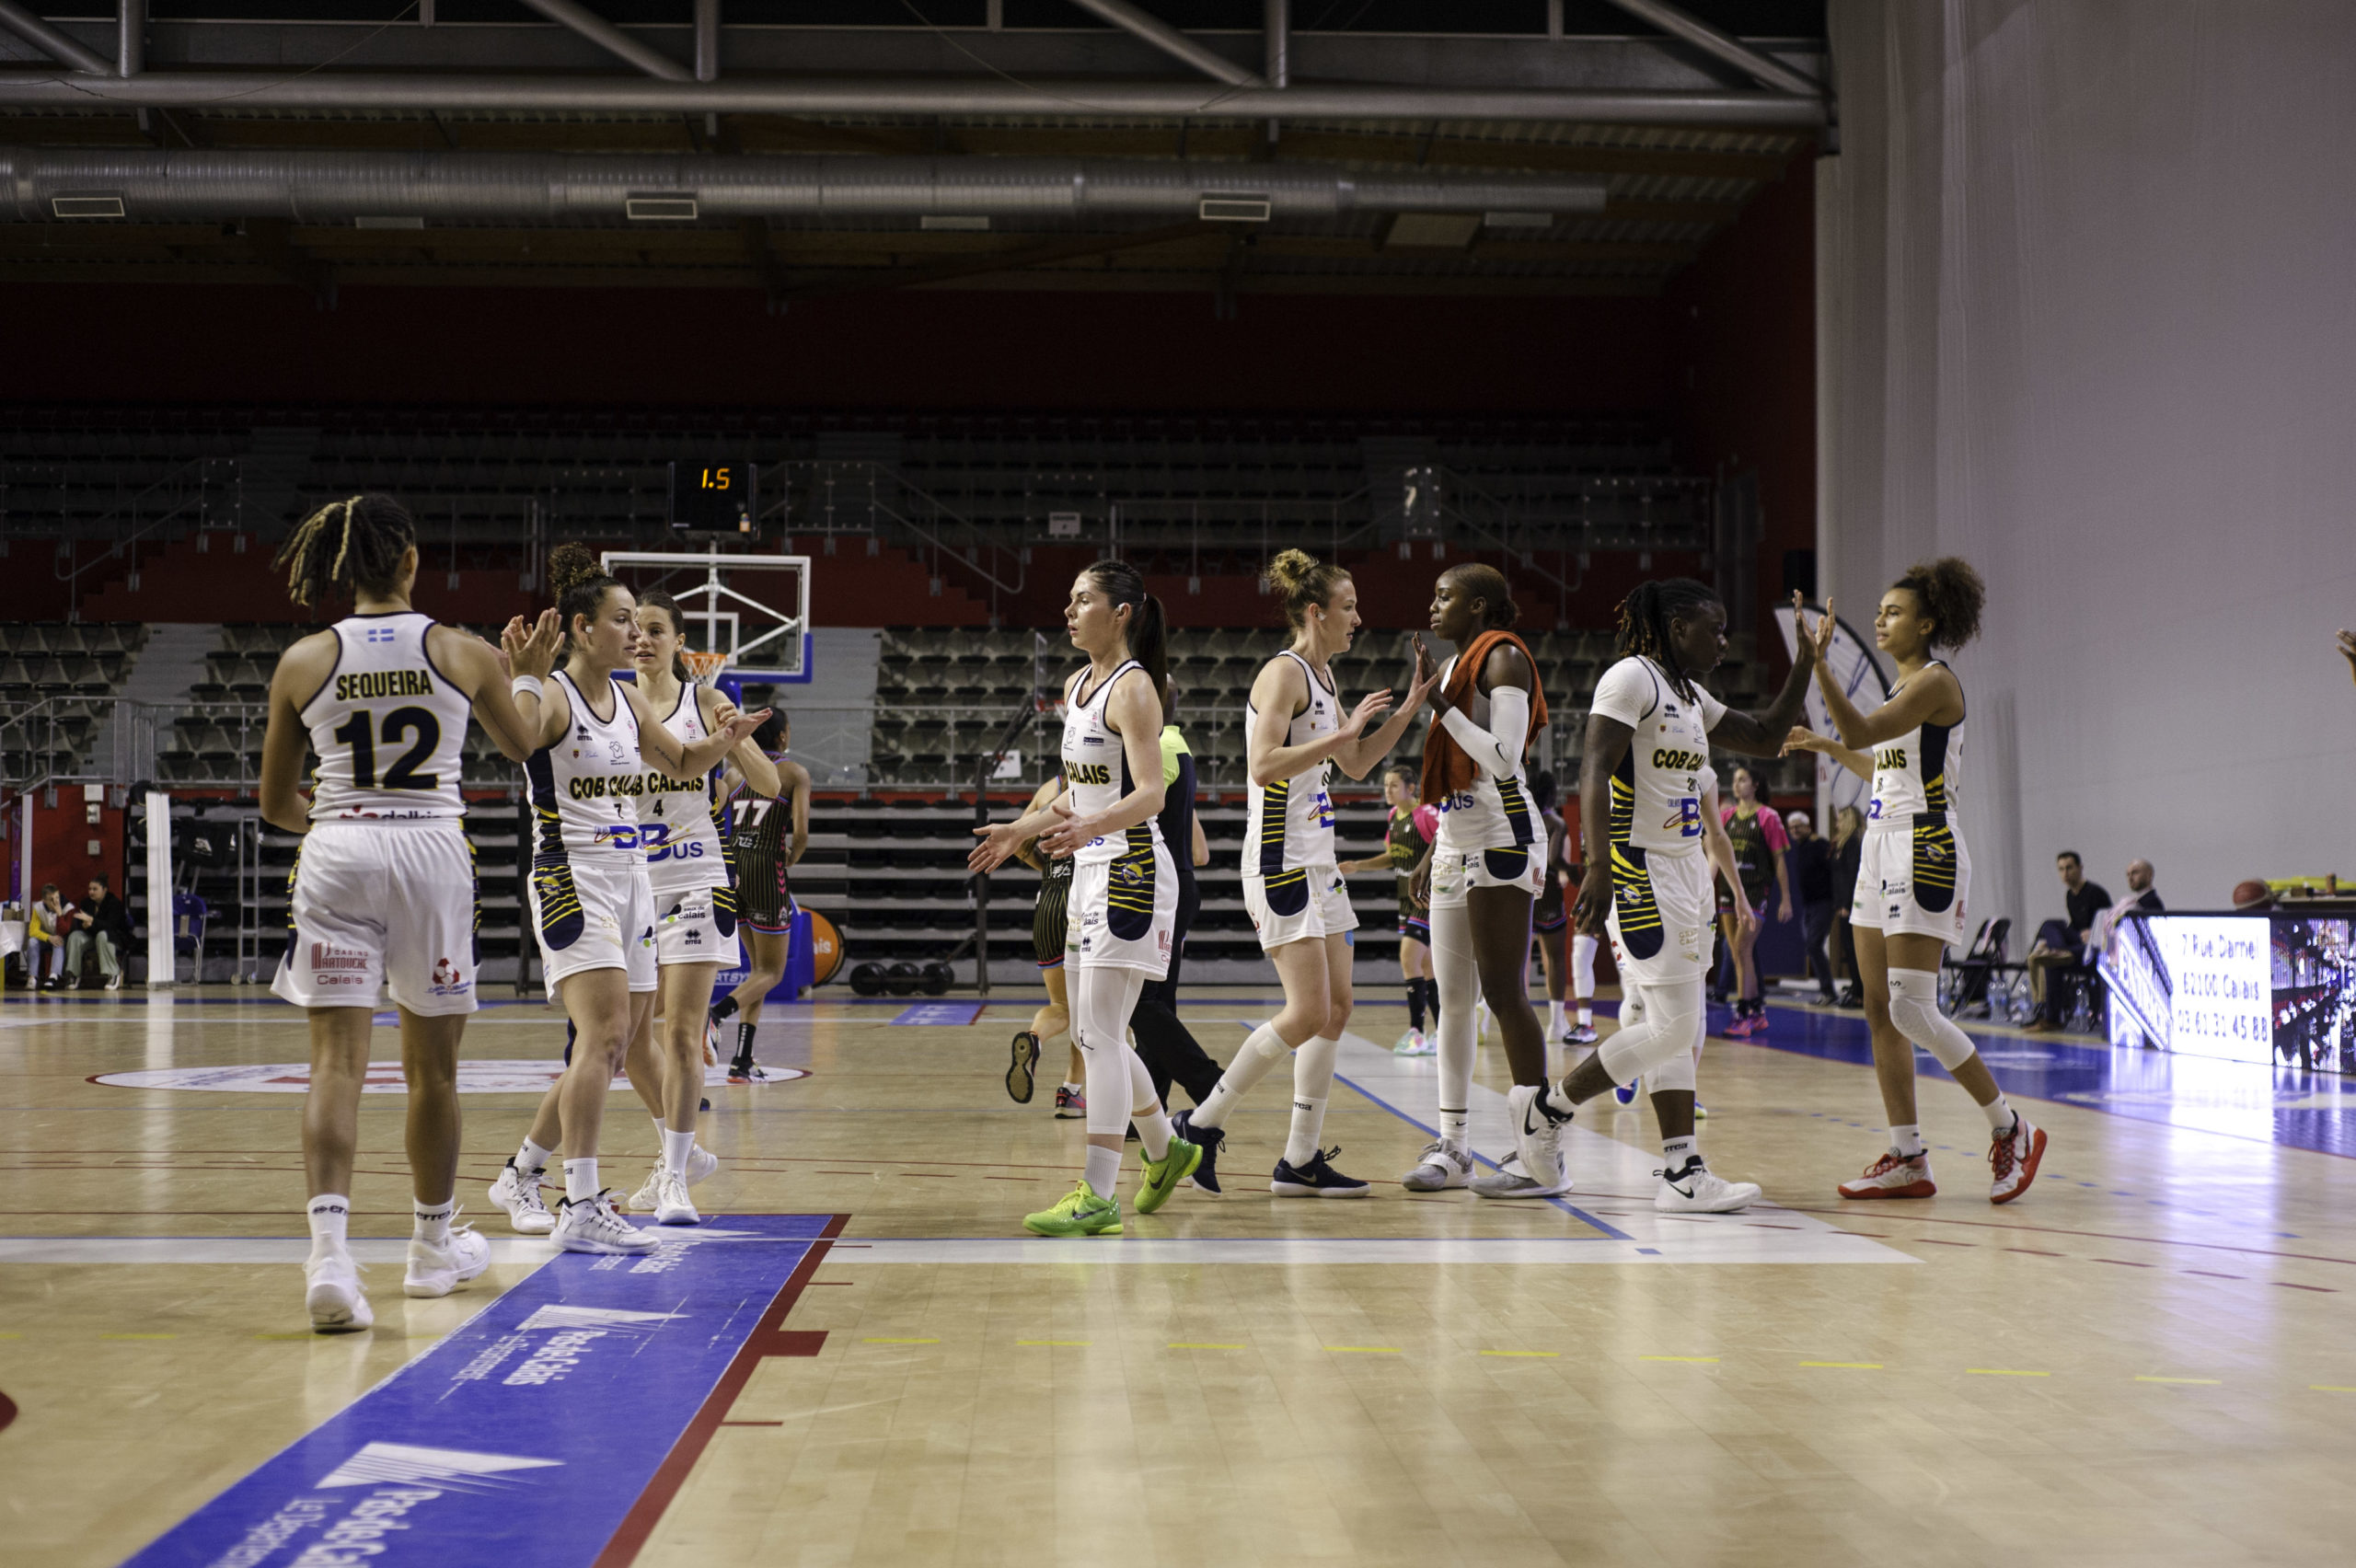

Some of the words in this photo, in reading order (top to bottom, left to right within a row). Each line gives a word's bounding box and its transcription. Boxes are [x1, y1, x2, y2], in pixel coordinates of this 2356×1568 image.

[701, 467, 731, 490] 1.5
[336, 669, 433, 700] SEQUEIRA
[334, 705, 441, 790] 12
[1652, 748, 1689, 770] COB
[570, 776, 606, 800] COB
[614, 802, 625, 820] 7
[653, 799, 664, 817] 4
[733, 798, 774, 827] 77
[677, 911, 706, 919] calais
[333, 949, 368, 957] CASINO
[2192, 933, 2214, 958] Rue
[317, 974, 363, 986] Calais
[2183, 971, 2218, 997] 62100
[2223, 973, 2260, 1001] Calais
[2195, 1010, 2208, 1036] 61
[2213, 1011, 2227, 1038] 31
[2232, 1014, 2247, 1041] 45
[2252, 1015, 2268, 1043] 88
